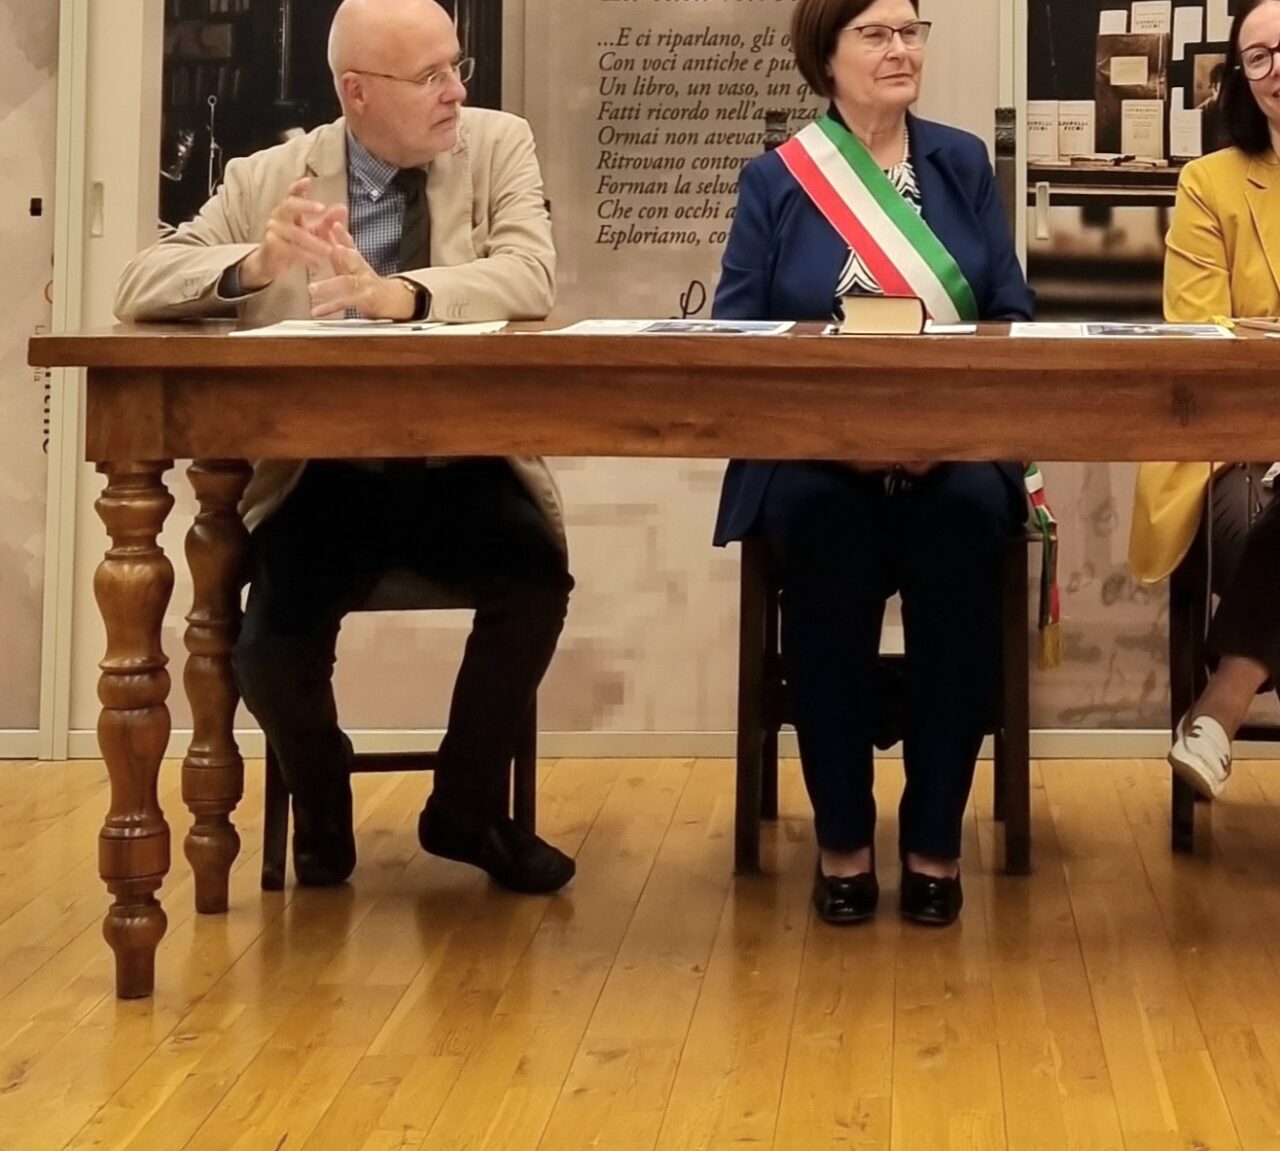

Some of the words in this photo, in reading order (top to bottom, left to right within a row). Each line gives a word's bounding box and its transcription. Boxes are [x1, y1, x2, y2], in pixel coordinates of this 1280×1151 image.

[635, 29, 651, 47] ci
[657, 26, 746, 54] riparlano,
[750, 26, 776, 54] gli
[598, 51, 635, 72] Con
[642, 53, 676, 72] voci
[682, 51, 749, 72] antiche
[753, 58, 764, 71] e
[765, 57, 796, 78] pur
[599, 76, 627, 96] Un
[632, 75, 681, 98] libro,
[687, 83, 711, 96] un
[717, 83, 760, 98] vaso,
[767, 83, 791, 96] un
[597, 100, 642, 121] Fatti
[647, 102, 710, 121] ricordo
[597, 126, 659, 146] Ormai
[664, 132, 699, 146] non
[703, 132, 767, 146] avevan
[596, 150, 686, 171] Ritrovano
[691, 154, 751, 171] contor
[596, 175, 668, 195] Forman
[673, 174, 692, 195] la
[695, 174, 740, 195] selva
[597, 199, 633, 219] Che
[637, 206, 668, 219] con
[674, 199, 721, 219] occhi
[596, 224, 701, 250] Esploriamo,
[708, 231, 729, 245] co
